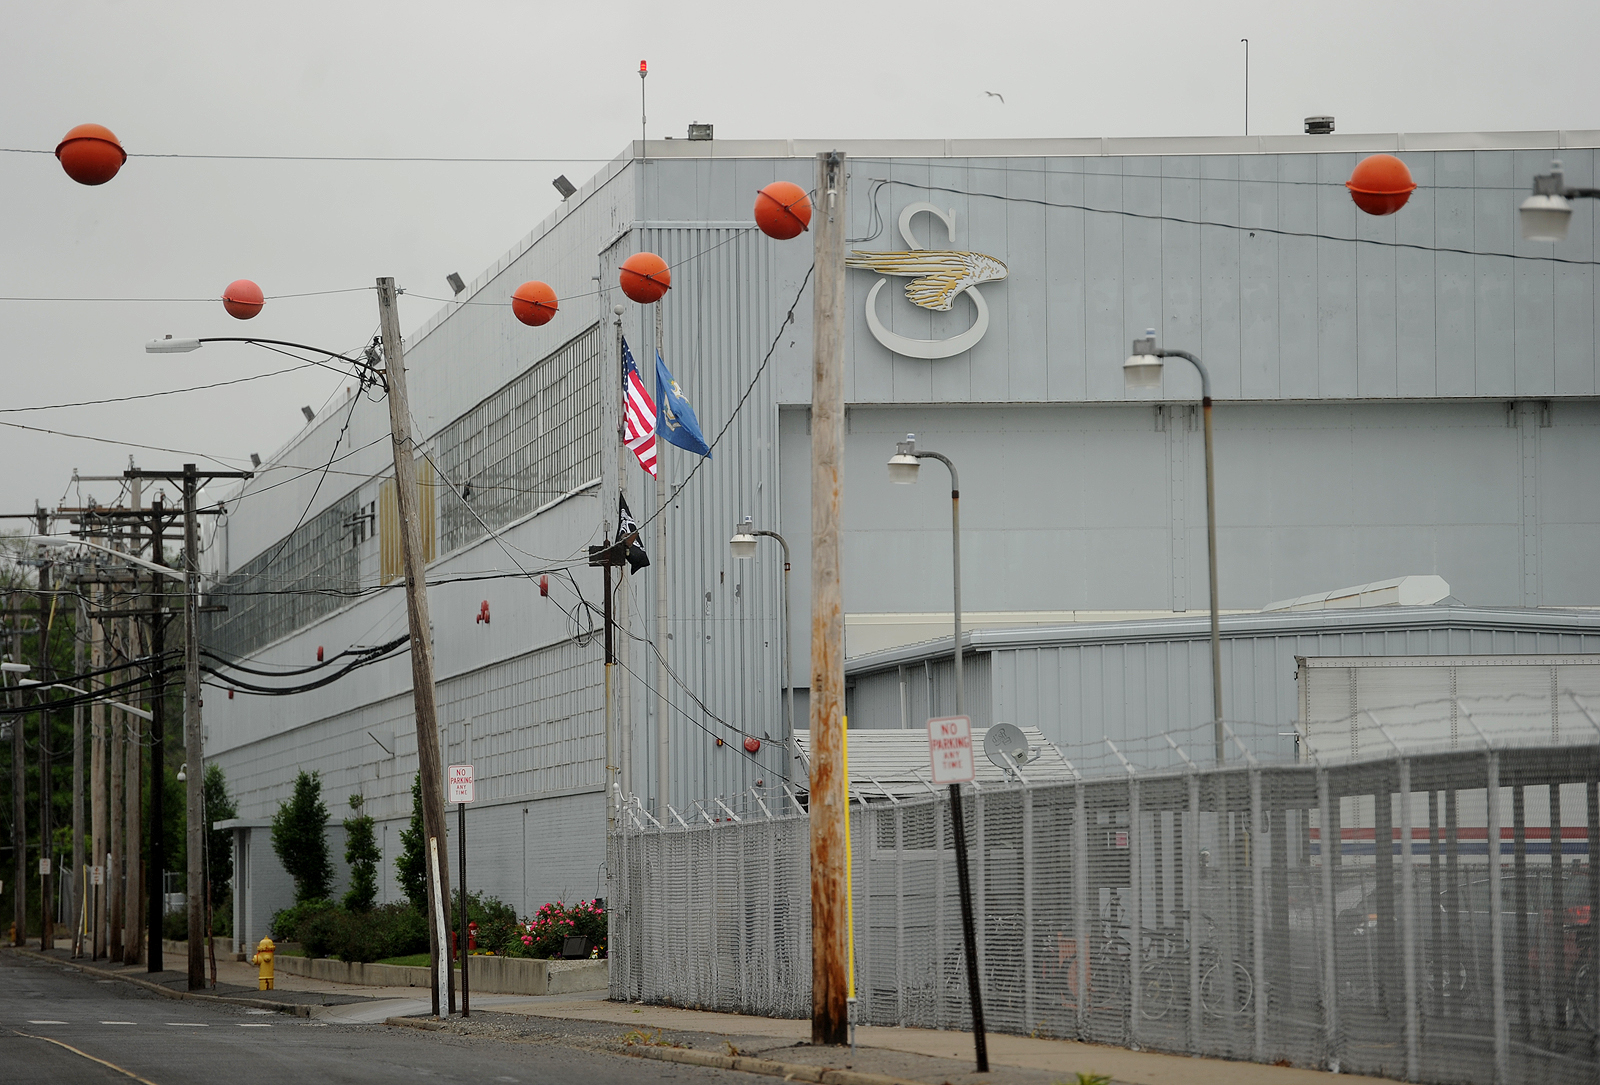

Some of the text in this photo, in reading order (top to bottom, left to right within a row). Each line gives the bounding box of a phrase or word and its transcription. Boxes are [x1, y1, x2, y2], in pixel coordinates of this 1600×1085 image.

[941, 723, 957, 735] NO
[932, 737, 970, 750] PARKING
[944, 751, 960, 759] ANY
[943, 760, 963, 769] TIME
